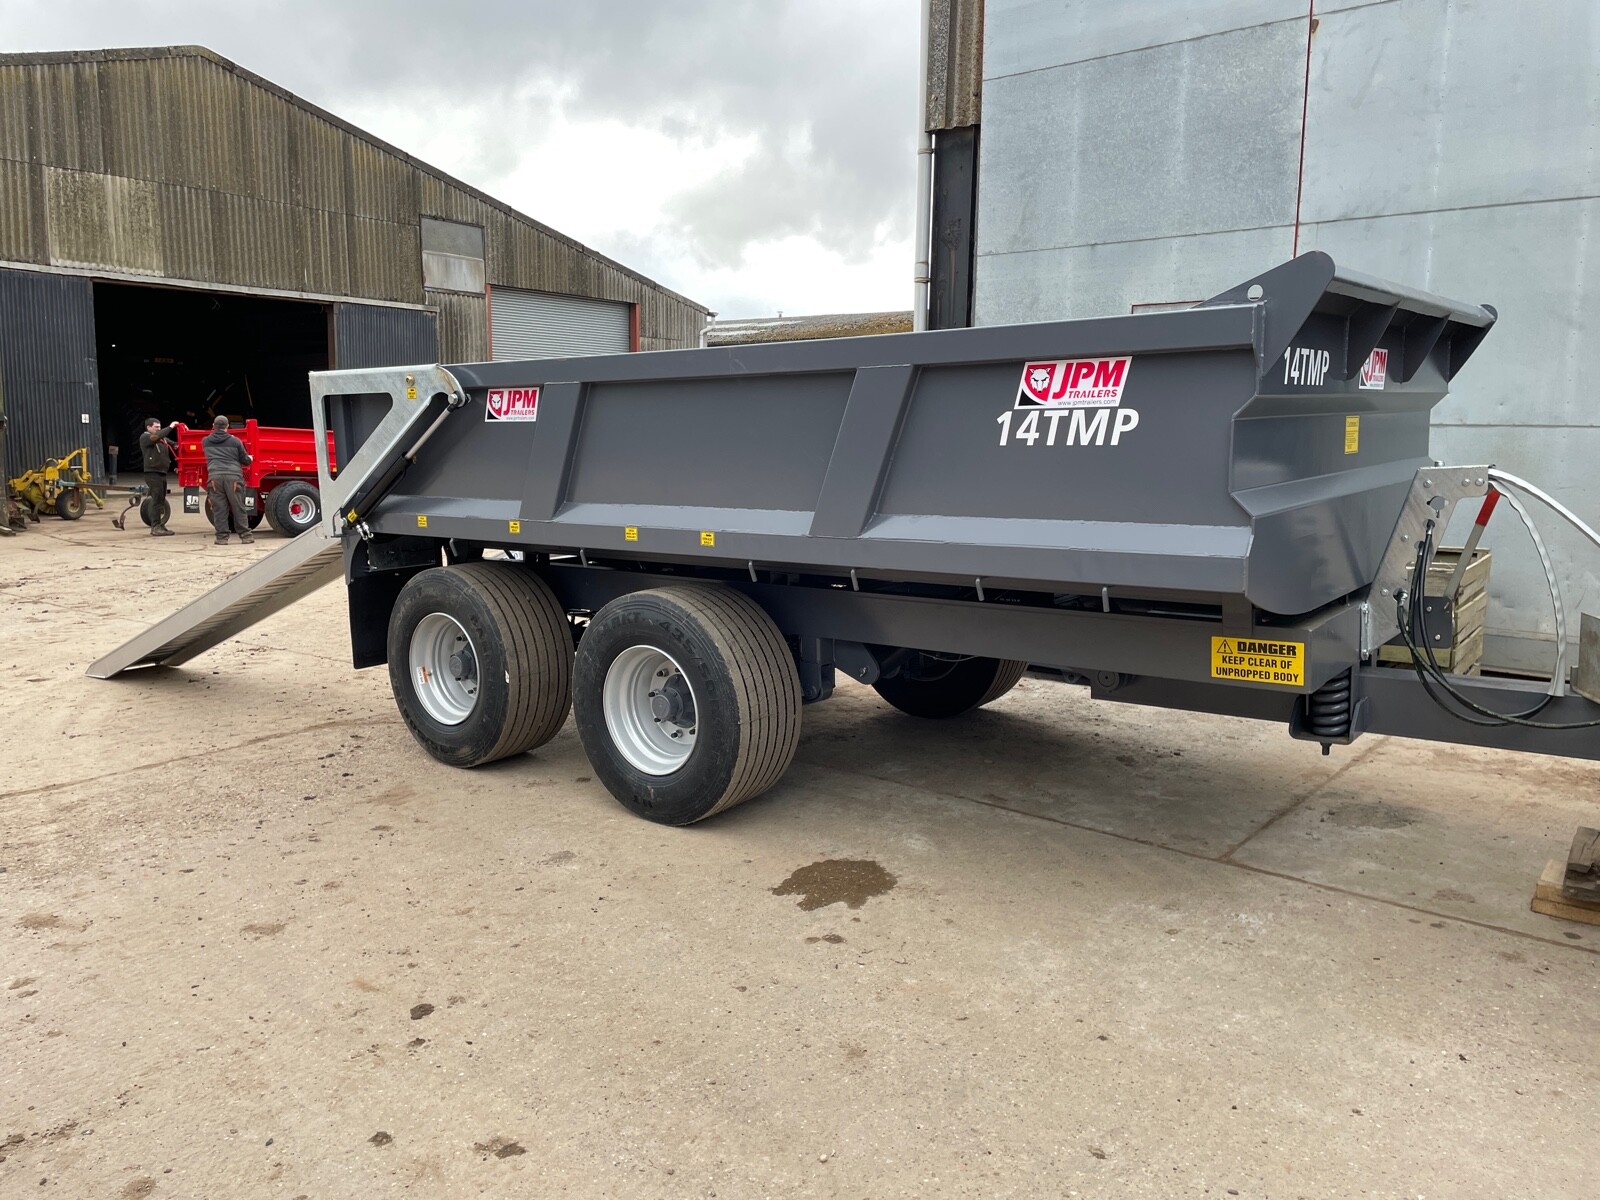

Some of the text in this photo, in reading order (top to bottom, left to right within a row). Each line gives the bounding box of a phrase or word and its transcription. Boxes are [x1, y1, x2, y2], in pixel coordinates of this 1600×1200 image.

[1284, 347, 1330, 386] 14TMP
[1052, 360, 1127, 399] JPM
[503, 390, 538, 416] JPM
[1068, 389, 1118, 399] TRAILERS
[996, 408, 1140, 446] 14TMP
[1237, 641, 1297, 656] DANGER
[1222, 655, 1293, 670] KEEP CLEAR OF
[1216, 666, 1299, 682] UNPROPPED BODY
